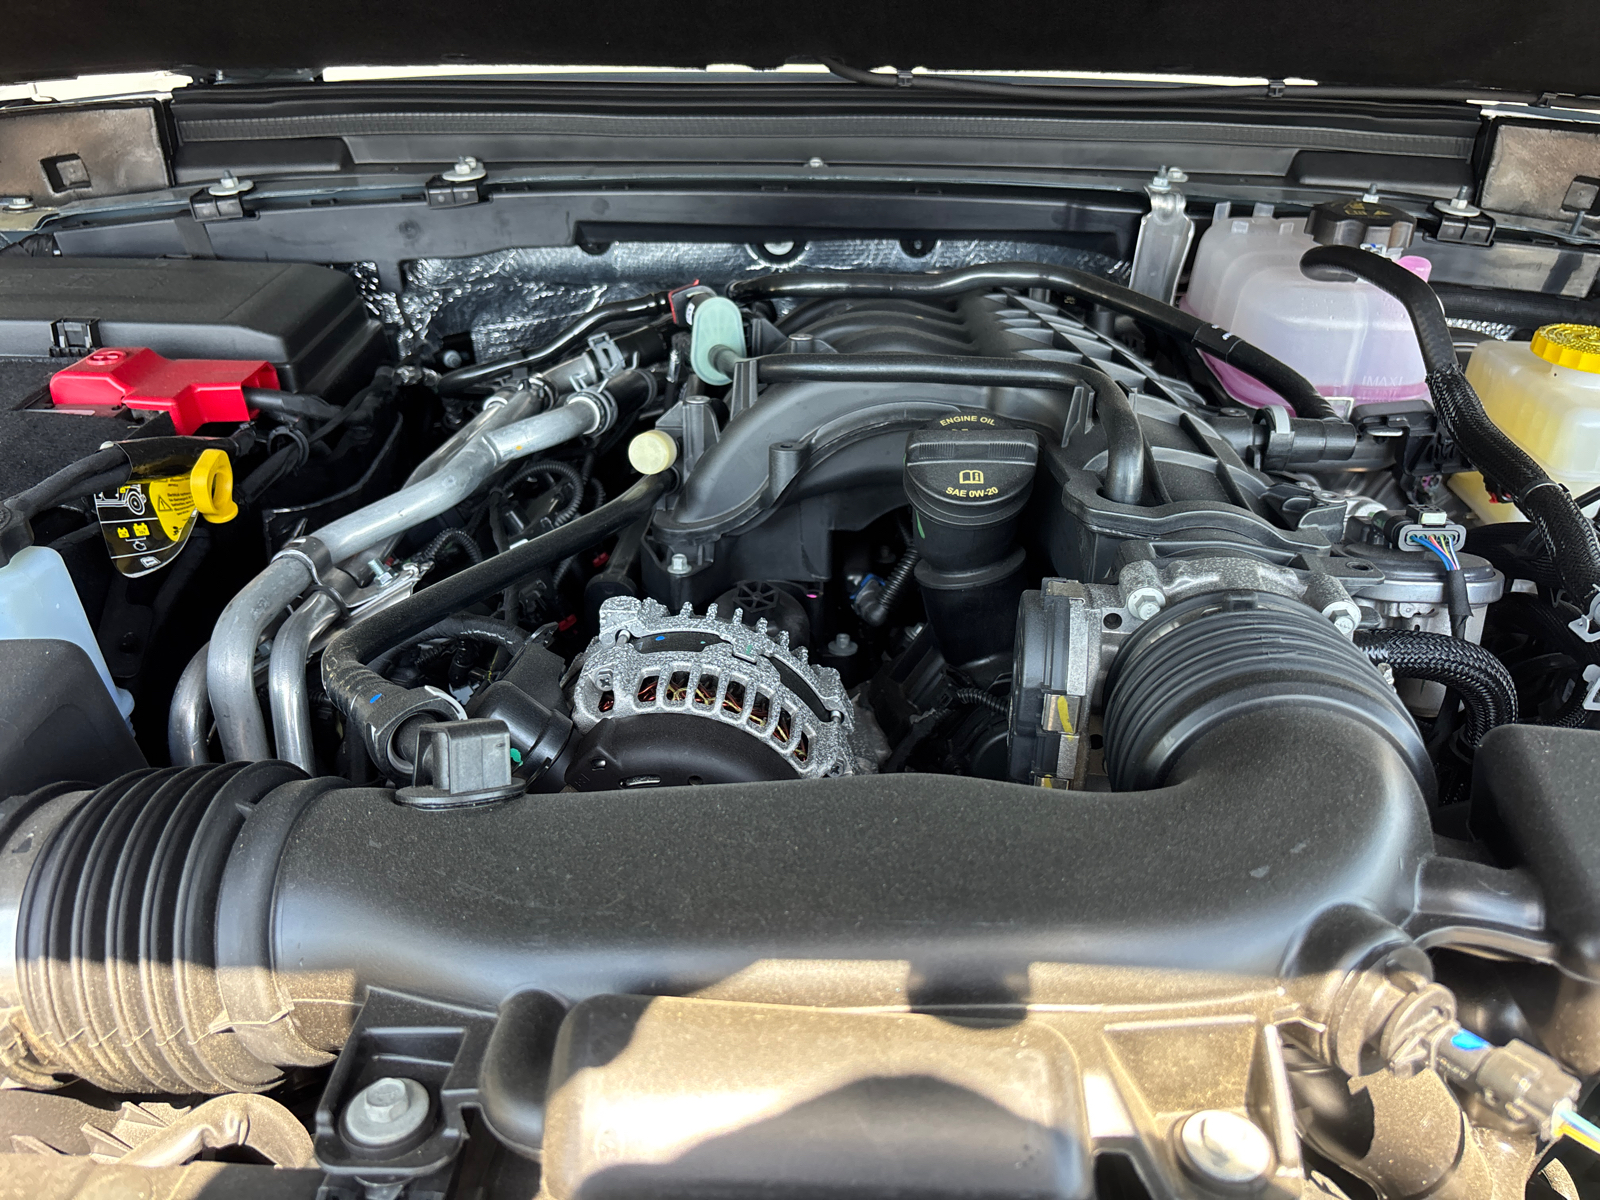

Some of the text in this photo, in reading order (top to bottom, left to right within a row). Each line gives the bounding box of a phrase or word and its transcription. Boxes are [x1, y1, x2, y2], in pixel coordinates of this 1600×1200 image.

[940, 415, 996, 427] ENGINE OIL
[945, 486, 999, 498] SAE 0W-20
